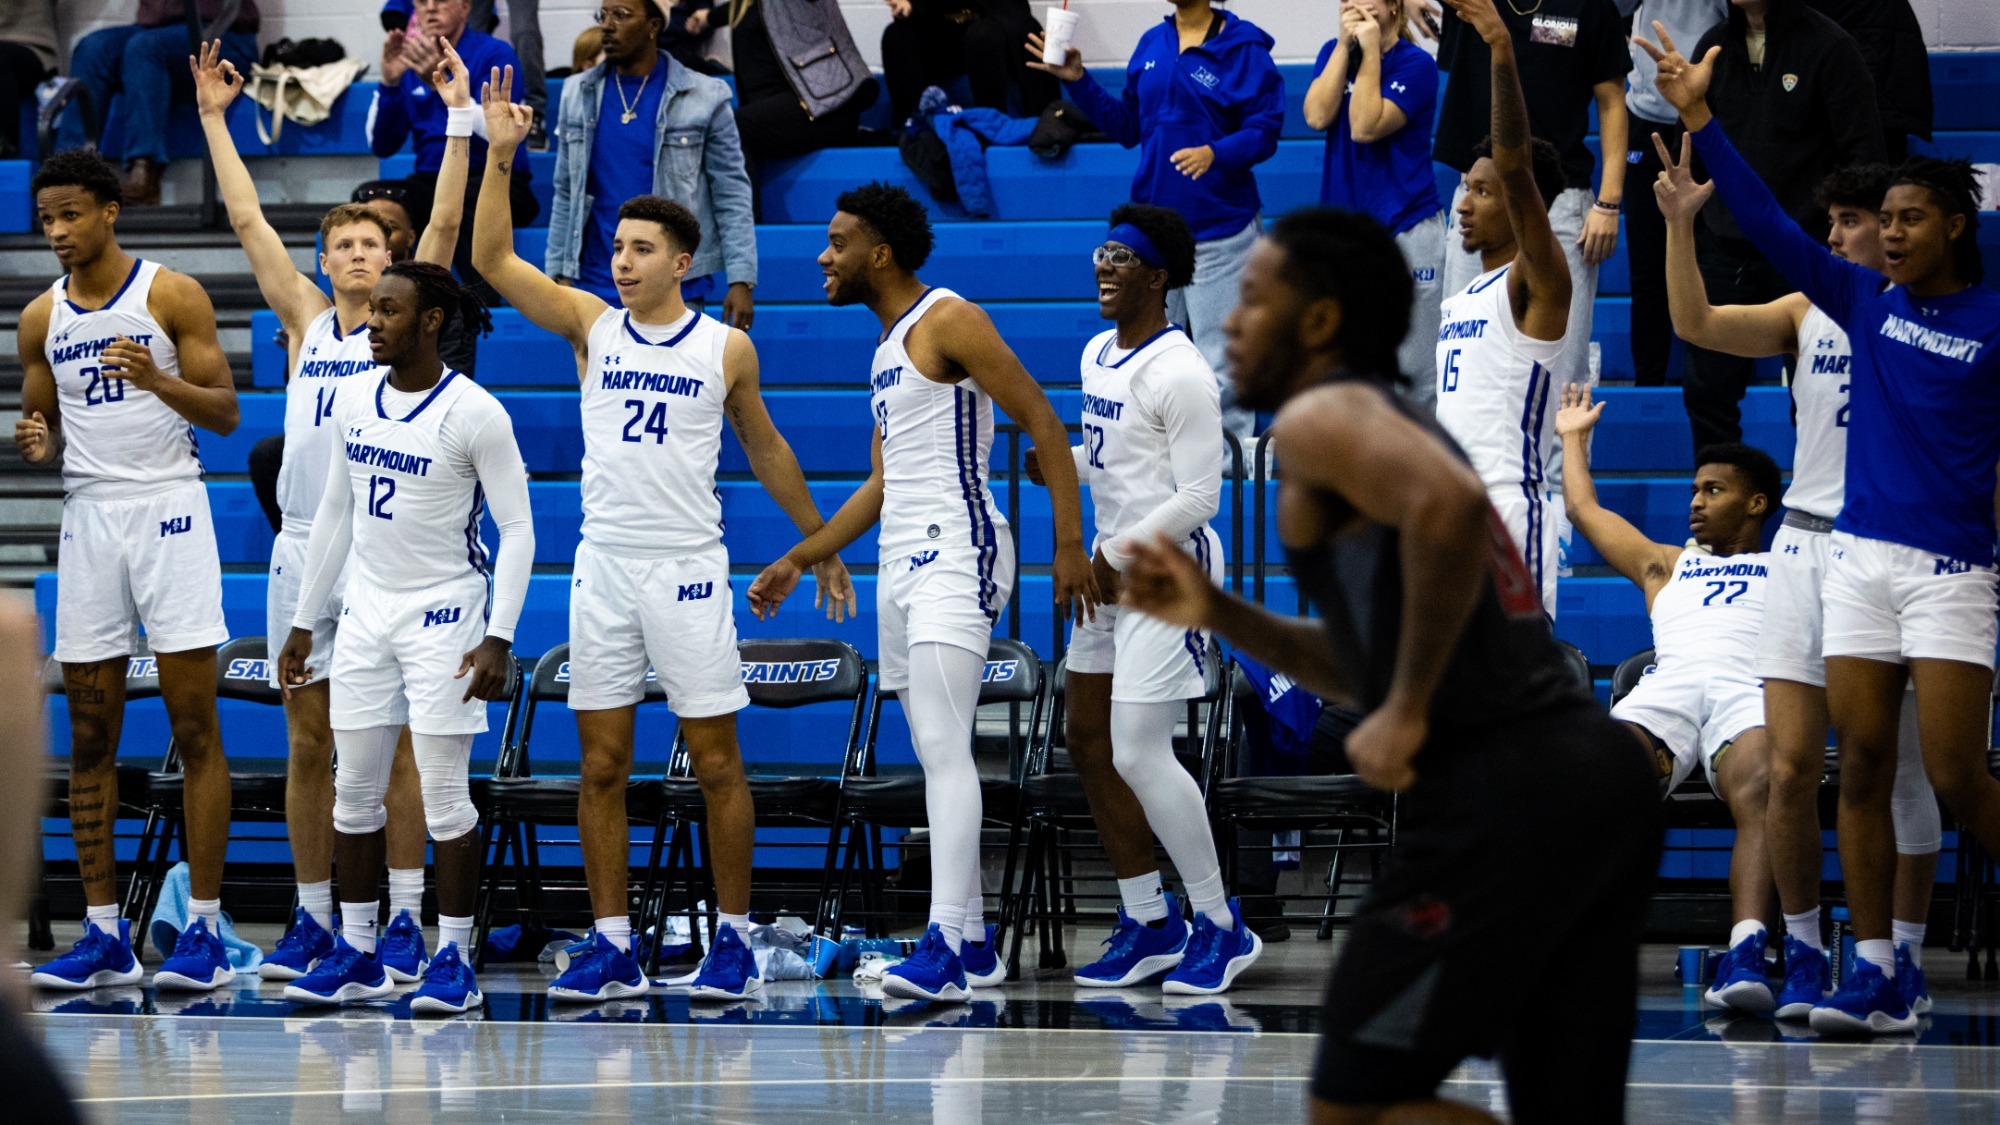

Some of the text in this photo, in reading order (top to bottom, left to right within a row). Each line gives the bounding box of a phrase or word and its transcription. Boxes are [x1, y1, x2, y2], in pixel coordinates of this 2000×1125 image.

[1532, 17, 1578, 31] GLORIOUS
[1879, 313, 1984, 364] MARYMOUNT
[79, 365, 125, 406] 20
[601, 370, 704, 398] MARYMOUNT
[1442, 348, 1462, 393] 15
[622, 399, 668, 445] 24
[346, 441, 432, 477] MARYMOUNT
[368, 474, 396, 521] 12
[160, 515, 192, 538] MU
[677, 581, 713, 601] MU
[423, 606, 461, 627] MU
[740, 658, 841, 684] SAINTS
